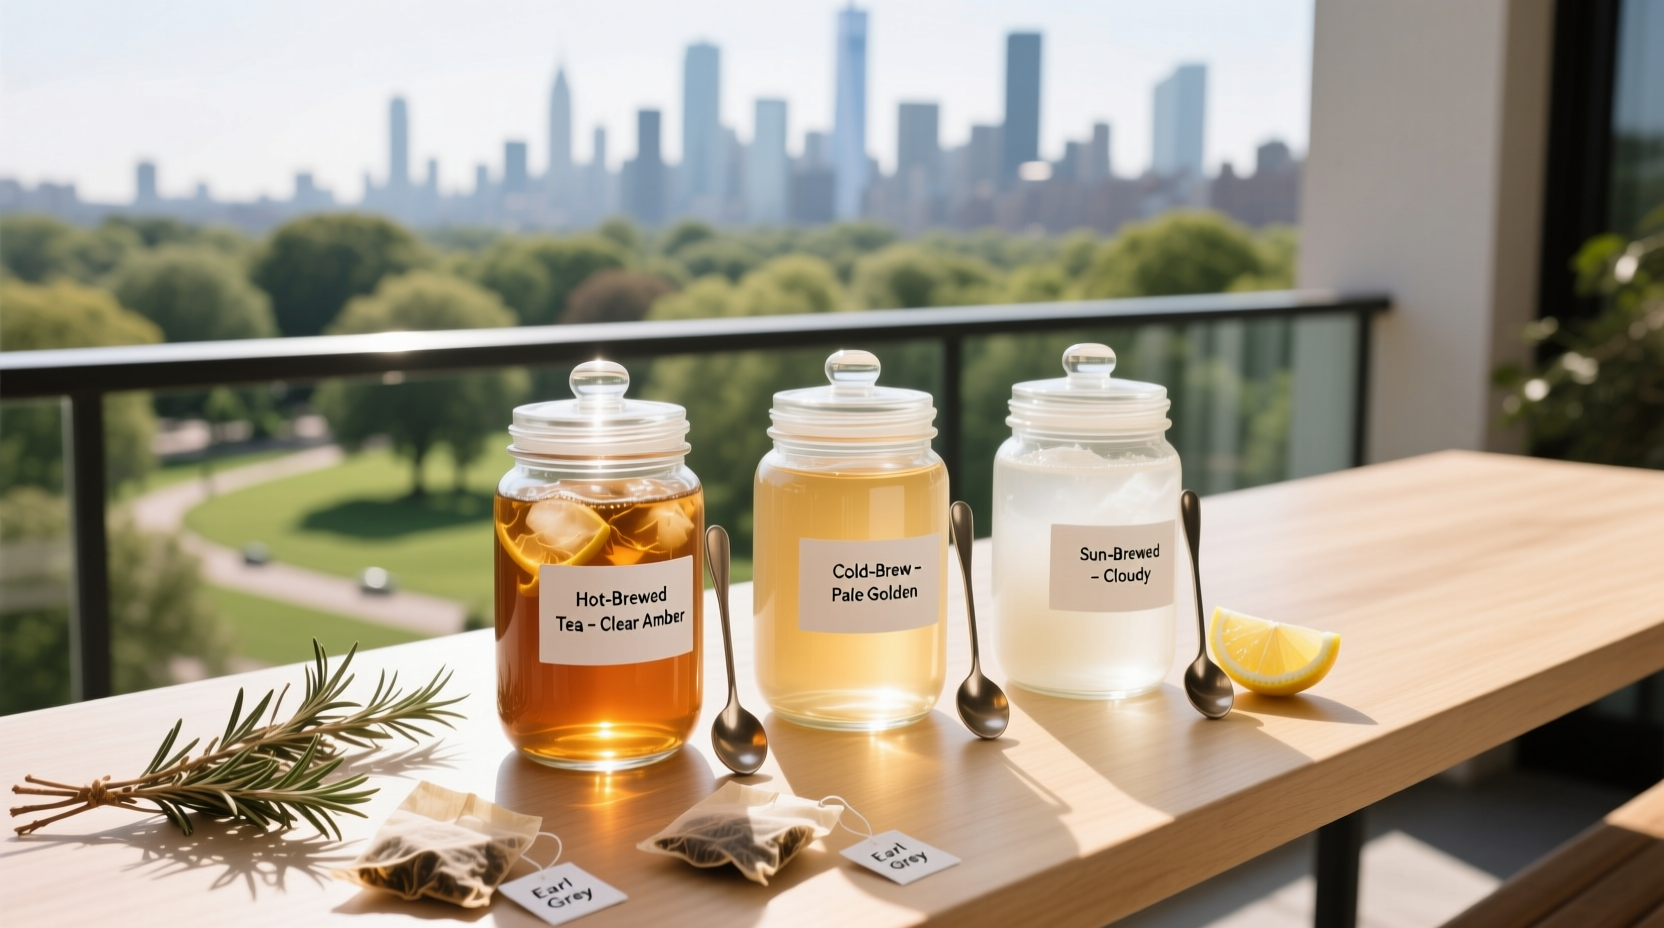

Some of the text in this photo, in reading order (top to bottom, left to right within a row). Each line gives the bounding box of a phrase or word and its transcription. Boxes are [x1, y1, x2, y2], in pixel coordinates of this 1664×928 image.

[1079, 542, 1160, 562] Sun-Brewed
[832, 562, 912, 579] Cold-Brew
[1103, 566, 1152, 585] Cloudy
[576, 585, 667, 608] Hot-Brewed
[831, 584, 918, 602] Pale Golden
[555, 615, 584, 632] Tea
[600, 614, 640, 632] Clear
[642, 608, 686, 629] Amber
[871, 842, 908, 863] Earl
[531, 877, 573, 900] Earl
[547, 887, 593, 909] Grey
